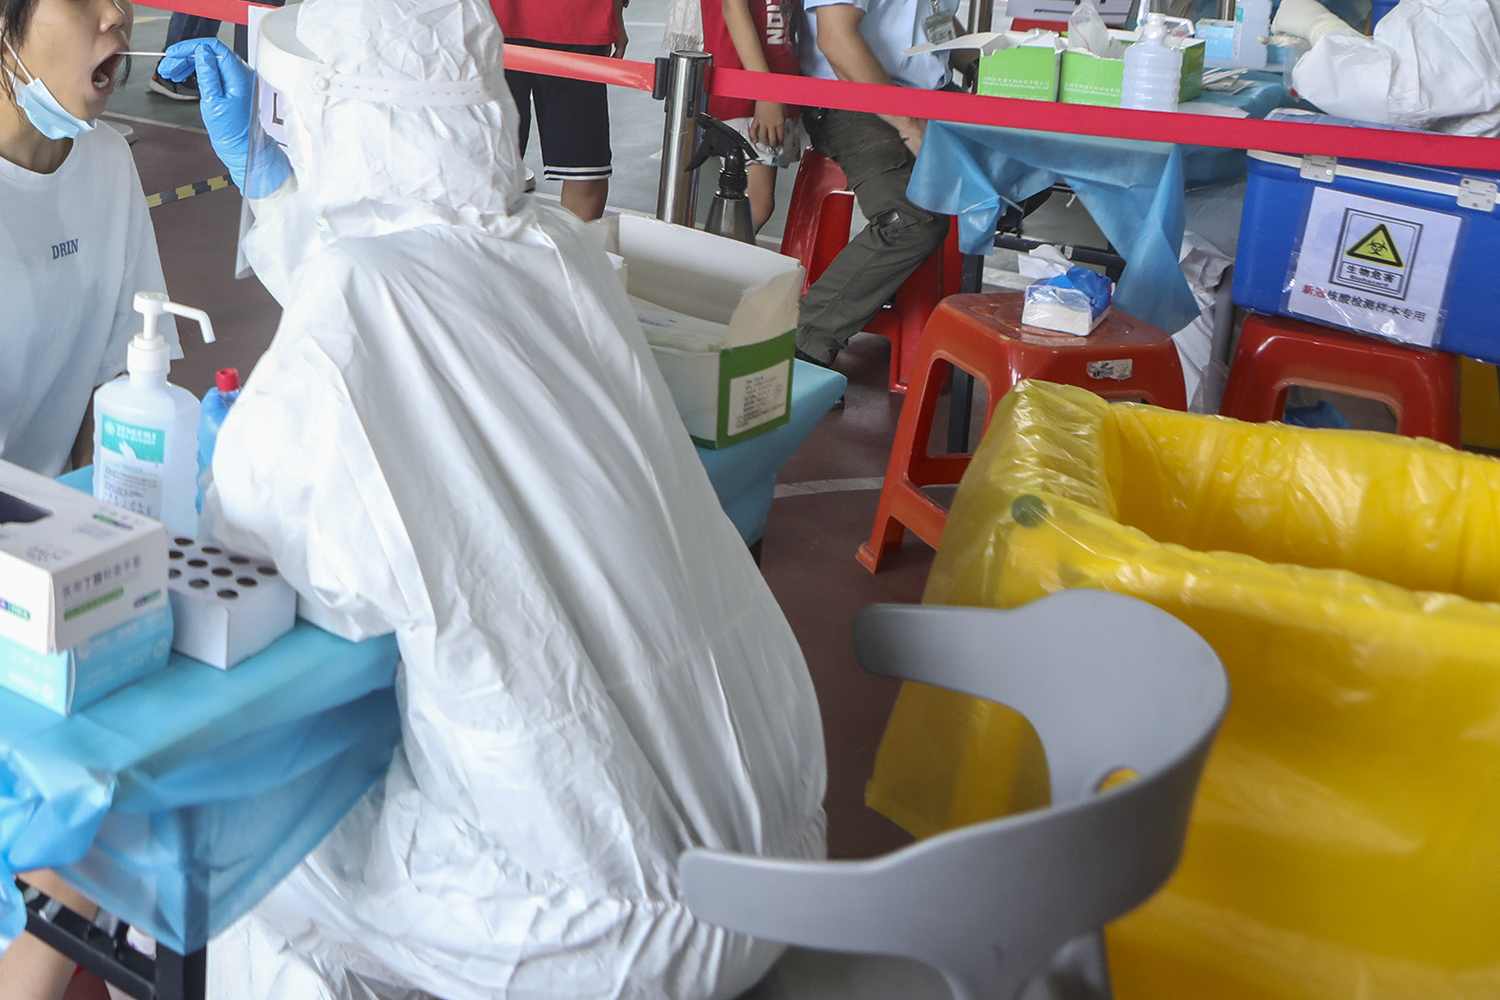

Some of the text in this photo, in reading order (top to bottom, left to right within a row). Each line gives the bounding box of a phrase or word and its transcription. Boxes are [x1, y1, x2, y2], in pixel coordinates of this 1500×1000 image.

[51, 239, 79, 260] DRIN
[1346, 265, 1396, 284] 生物危害
